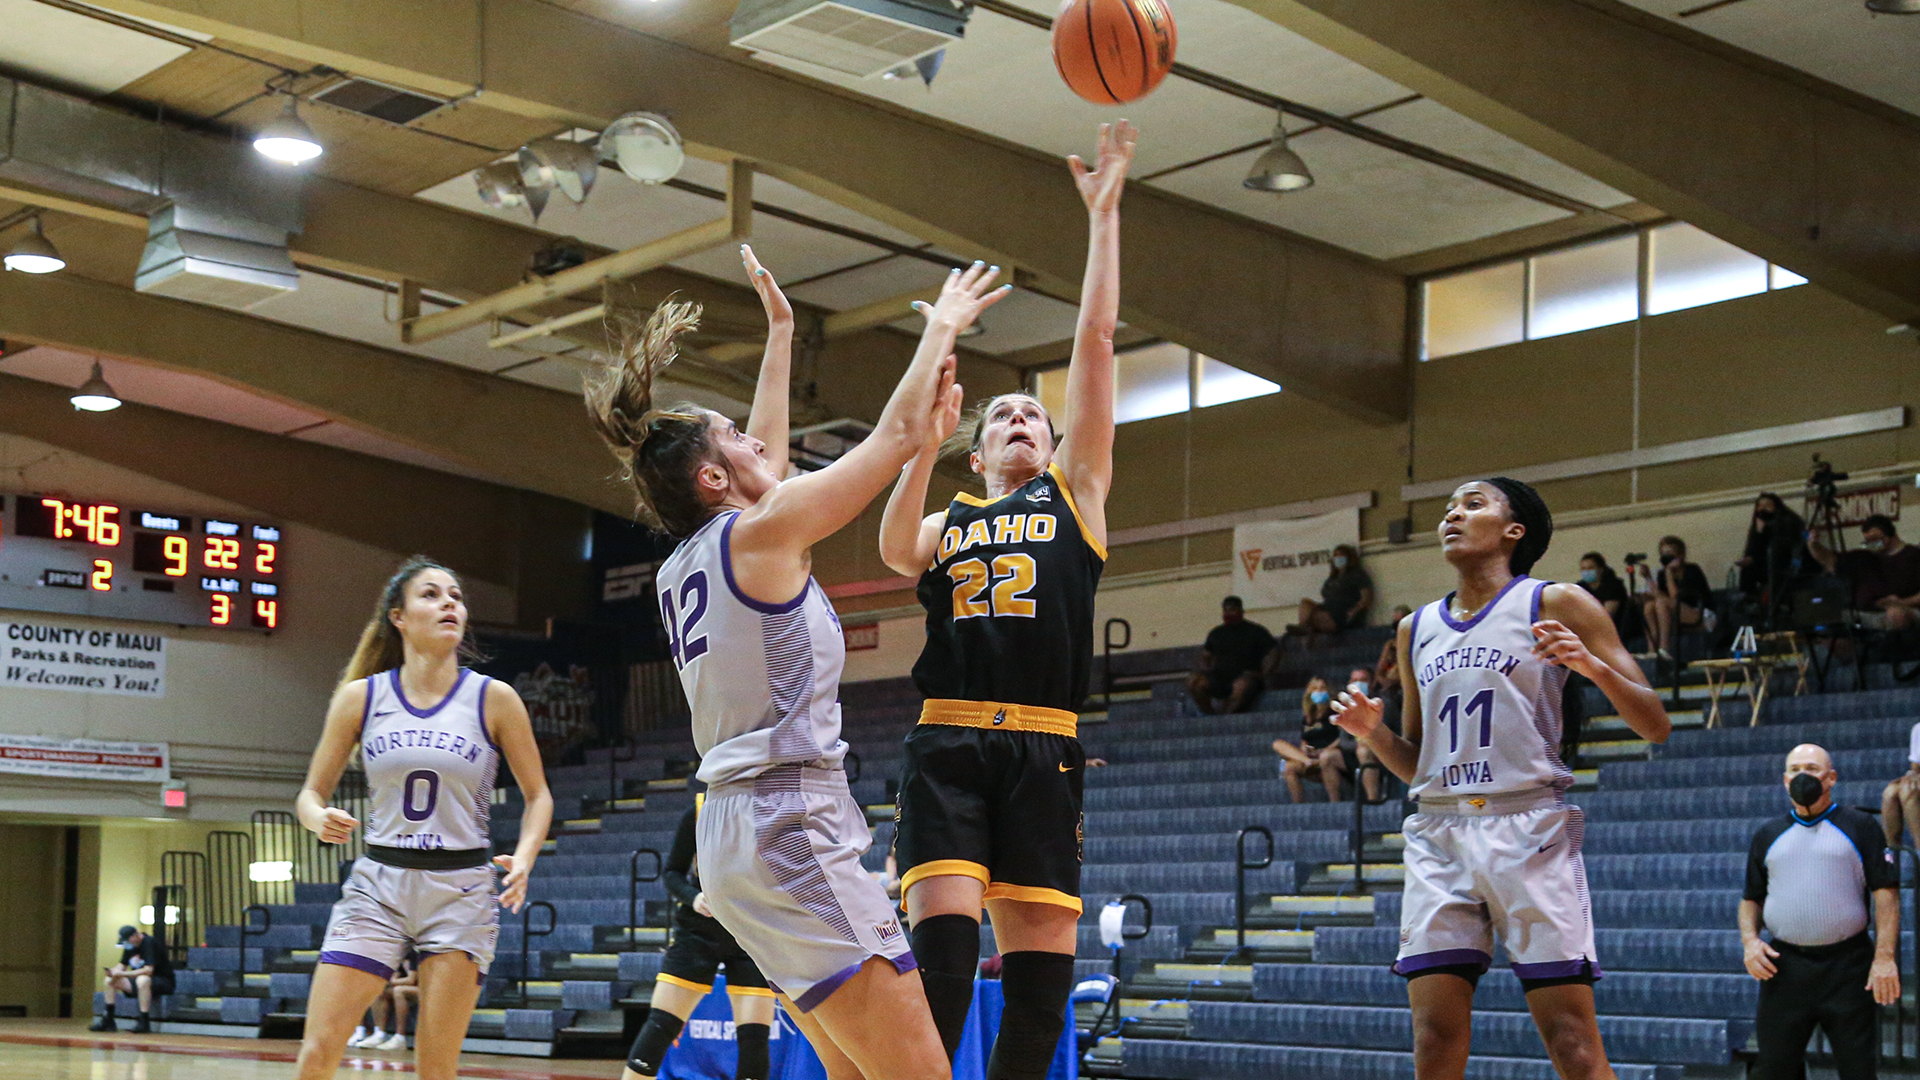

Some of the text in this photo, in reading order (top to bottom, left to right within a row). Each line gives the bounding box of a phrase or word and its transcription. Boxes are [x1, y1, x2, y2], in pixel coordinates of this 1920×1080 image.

[41, 498, 120, 546] 7:46
[163, 535, 188, 577] 9
[203, 537, 240, 570] 22
[255, 543, 276, 574] 2
[92, 559, 113, 591] 2
[947, 552, 1037, 623] 22
[211, 594, 230, 625] 3
[256, 600, 277, 628] 4
[661, 568, 709, 672] 42
[8, 624, 162, 652] COUNTY OF MAUI
[11, 648, 156, 670] Parks & Recreation
[1419, 646, 1521, 688] NORTHERN
[6, 666, 159, 692] Welcomes You!
[1438, 687, 1496, 754] 11
[365, 729, 482, 764] NORTHERN
[1442, 760, 1494, 788] IOWA
[403, 769, 439, 822] 0
[690, 1020, 722, 1039] VERTICAL
